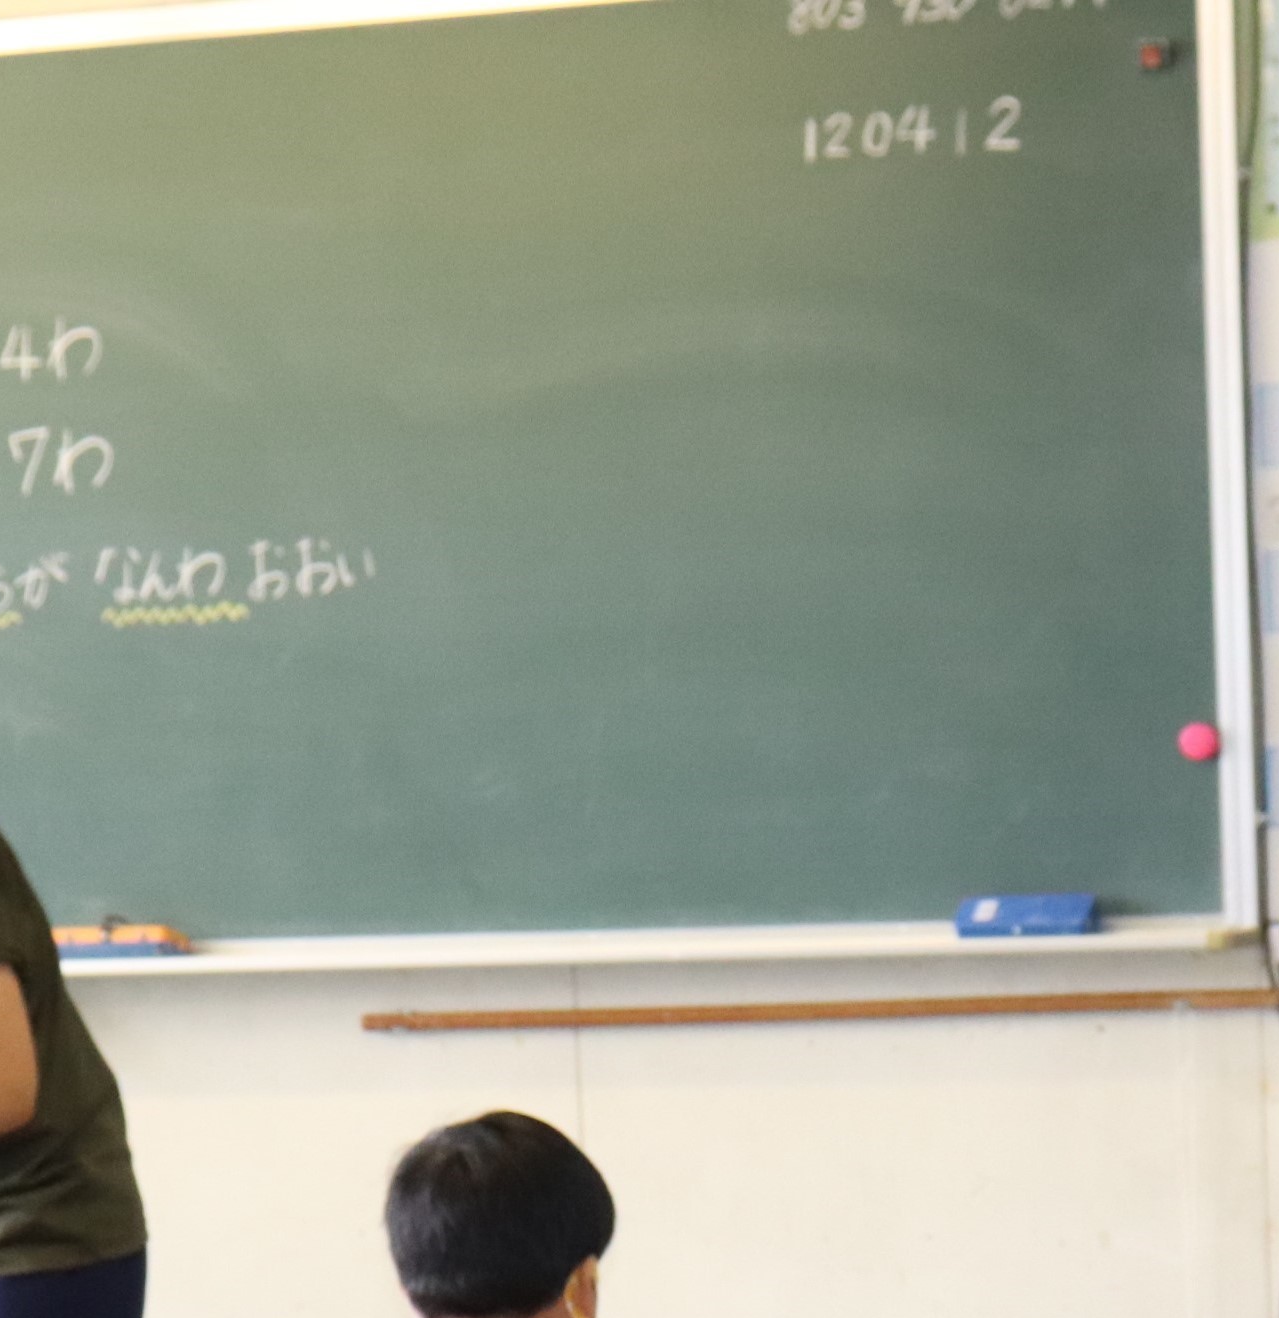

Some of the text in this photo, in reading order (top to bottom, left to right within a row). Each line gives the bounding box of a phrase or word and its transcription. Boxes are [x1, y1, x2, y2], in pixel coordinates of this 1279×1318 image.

[8, 425, 115, 496] 7わ
[93, 544, 226, 605] なんわ
[245, 536, 377, 602] おおい
